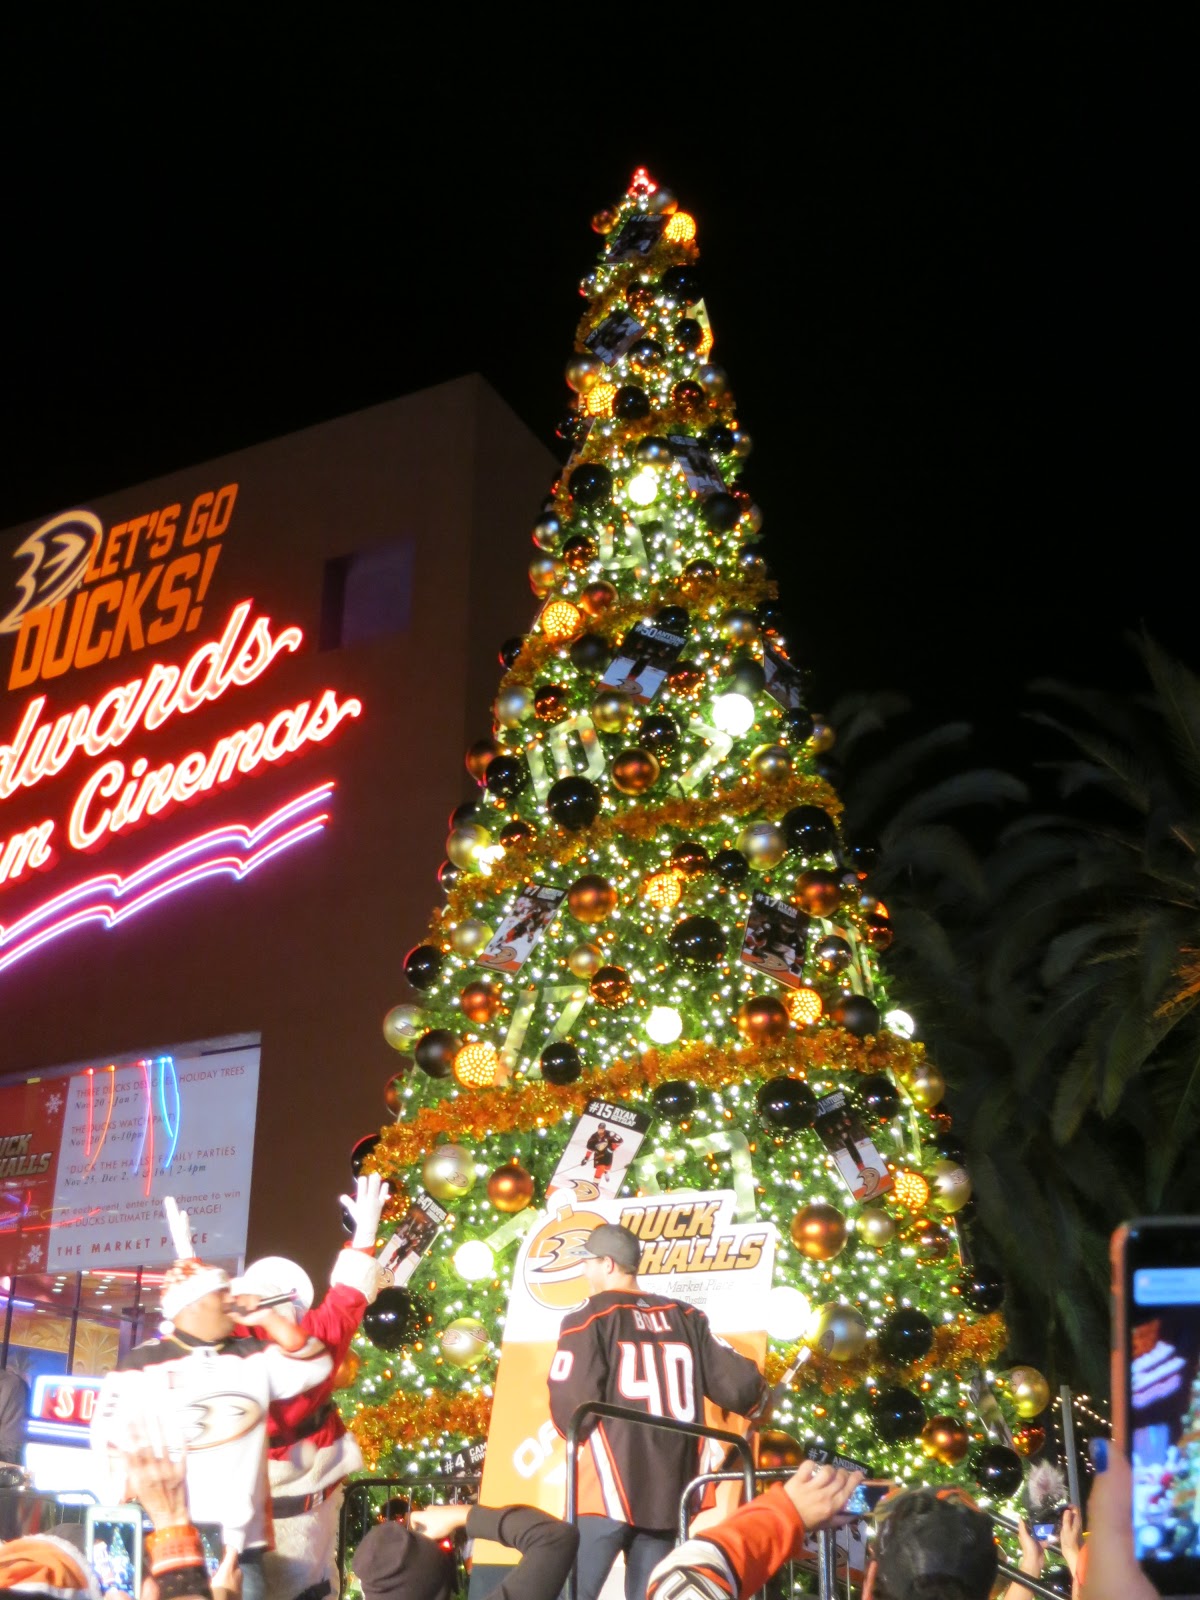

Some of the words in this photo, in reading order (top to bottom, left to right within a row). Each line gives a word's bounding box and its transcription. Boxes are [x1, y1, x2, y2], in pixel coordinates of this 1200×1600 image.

[83, 503, 181, 584] LET'S
[182, 483, 238, 548] GO
[8, 544, 222, 691] DUCKS!
[68, 690, 362, 851] Cinemas
[180, 1070, 217, 1083] HOLIDAY
[220, 1065, 245, 1077] TREES
[120, 1116, 150, 1127] WATC
[588, 1101, 614, 1119] #15
[613, 1107, 638, 1121] RYAN
[100, 1160, 117, 1170] THE
[158, 1150, 193, 1162] FMILY
[197, 1146, 236, 1158] PARTIES
[211, 1191, 221, 1200] to
[224, 1190, 241, 1199] win
[75, 1215, 105, 1228] DUCKS
[109, 1210, 151, 1224] ULTIMATE
[153, 1209, 167, 1218] FA
[617, 1199, 724, 1240] DUCK
[57, 1244, 81, 1257] THE
[91, 1237, 150, 1254] MARKET
[161, 1232, 208, 1248] PCE
[638, 1232, 768, 1276] HALLS
[666, 1280, 703, 1294] Market
[632, 1308, 673, 1334] BOLL
[617, 1341, 695, 1423] 40
[445, 1453, 465, 1475] #4
[469, 1441, 487, 1457] CAM
[808, 1447, 829, 1463] #7
